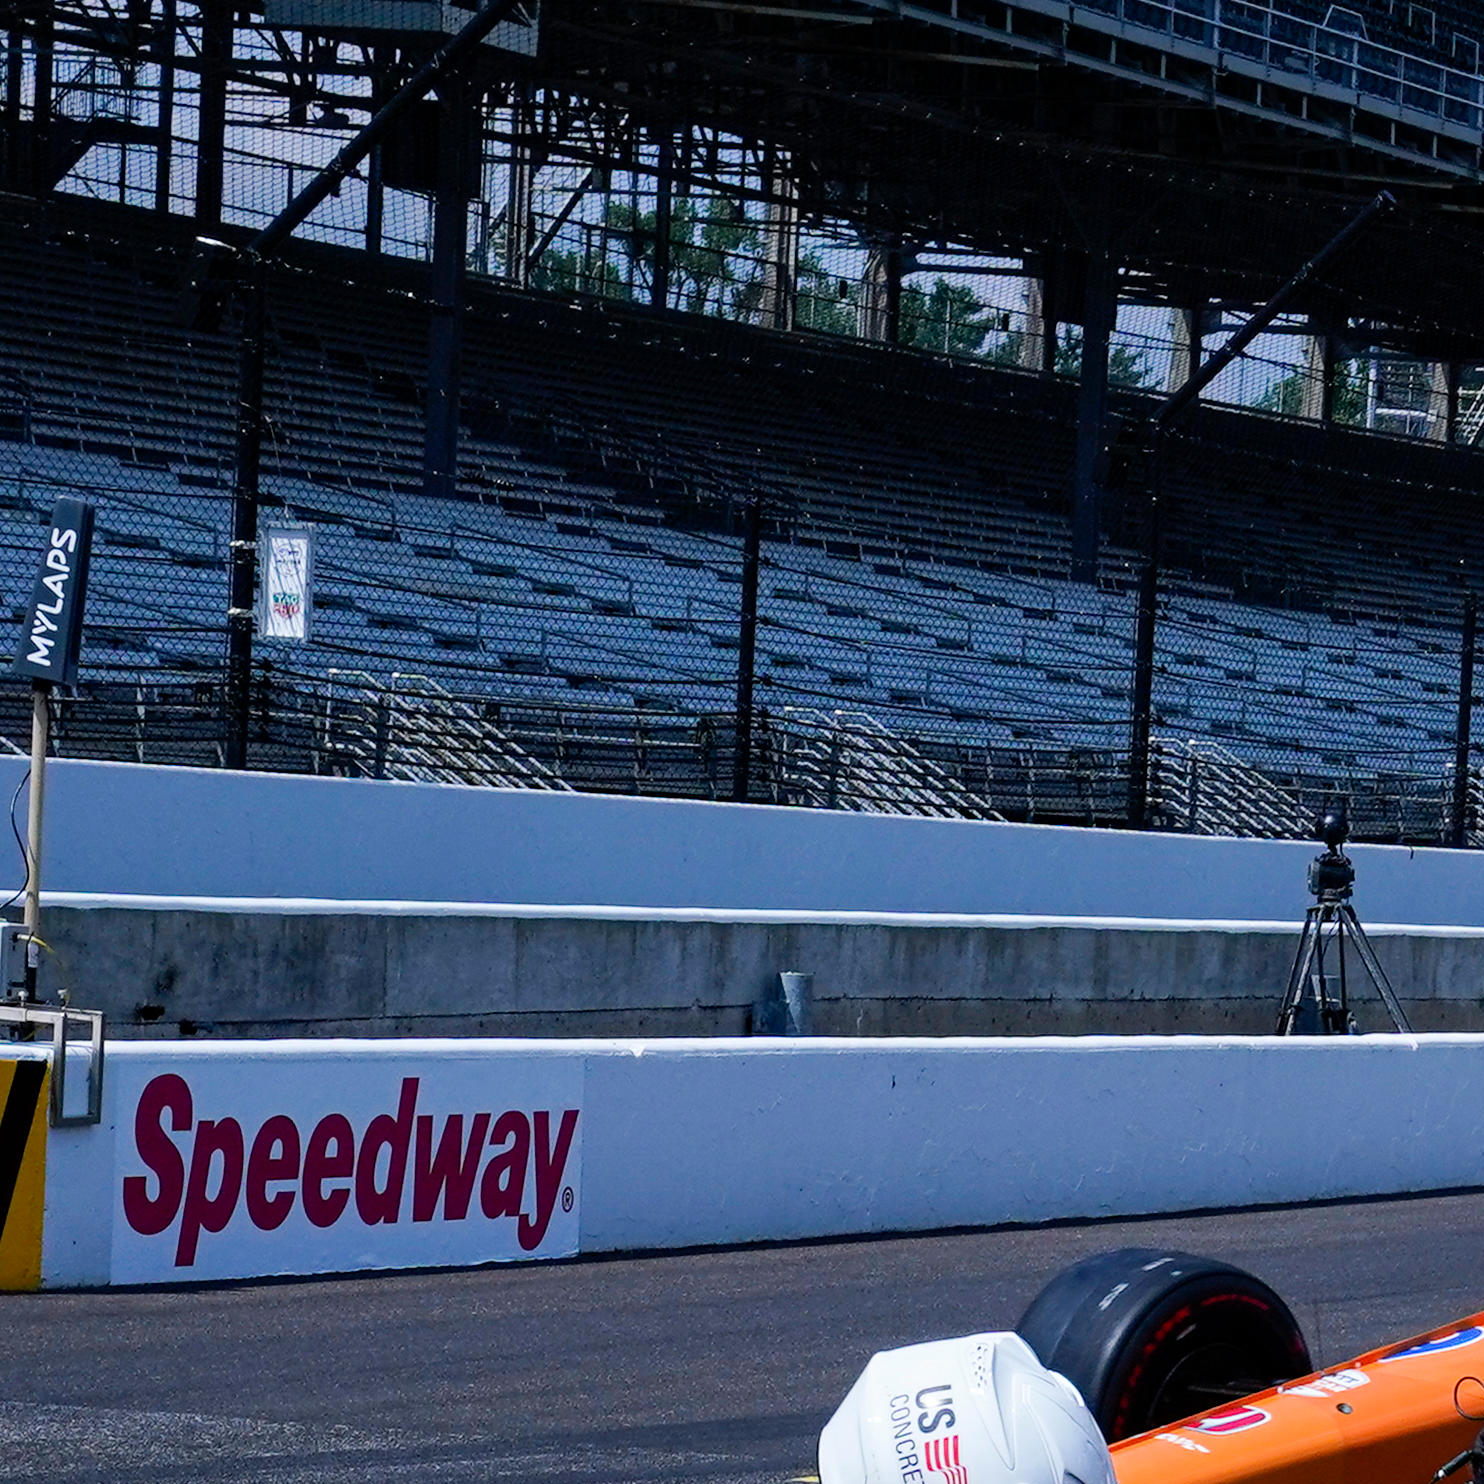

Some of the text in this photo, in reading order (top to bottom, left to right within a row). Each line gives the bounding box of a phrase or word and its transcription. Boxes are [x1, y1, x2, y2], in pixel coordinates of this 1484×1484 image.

[27, 526, 76, 667] MYLAPS
[122, 1073, 580, 1267] Speedway
[914, 1384, 956, 1434] US
